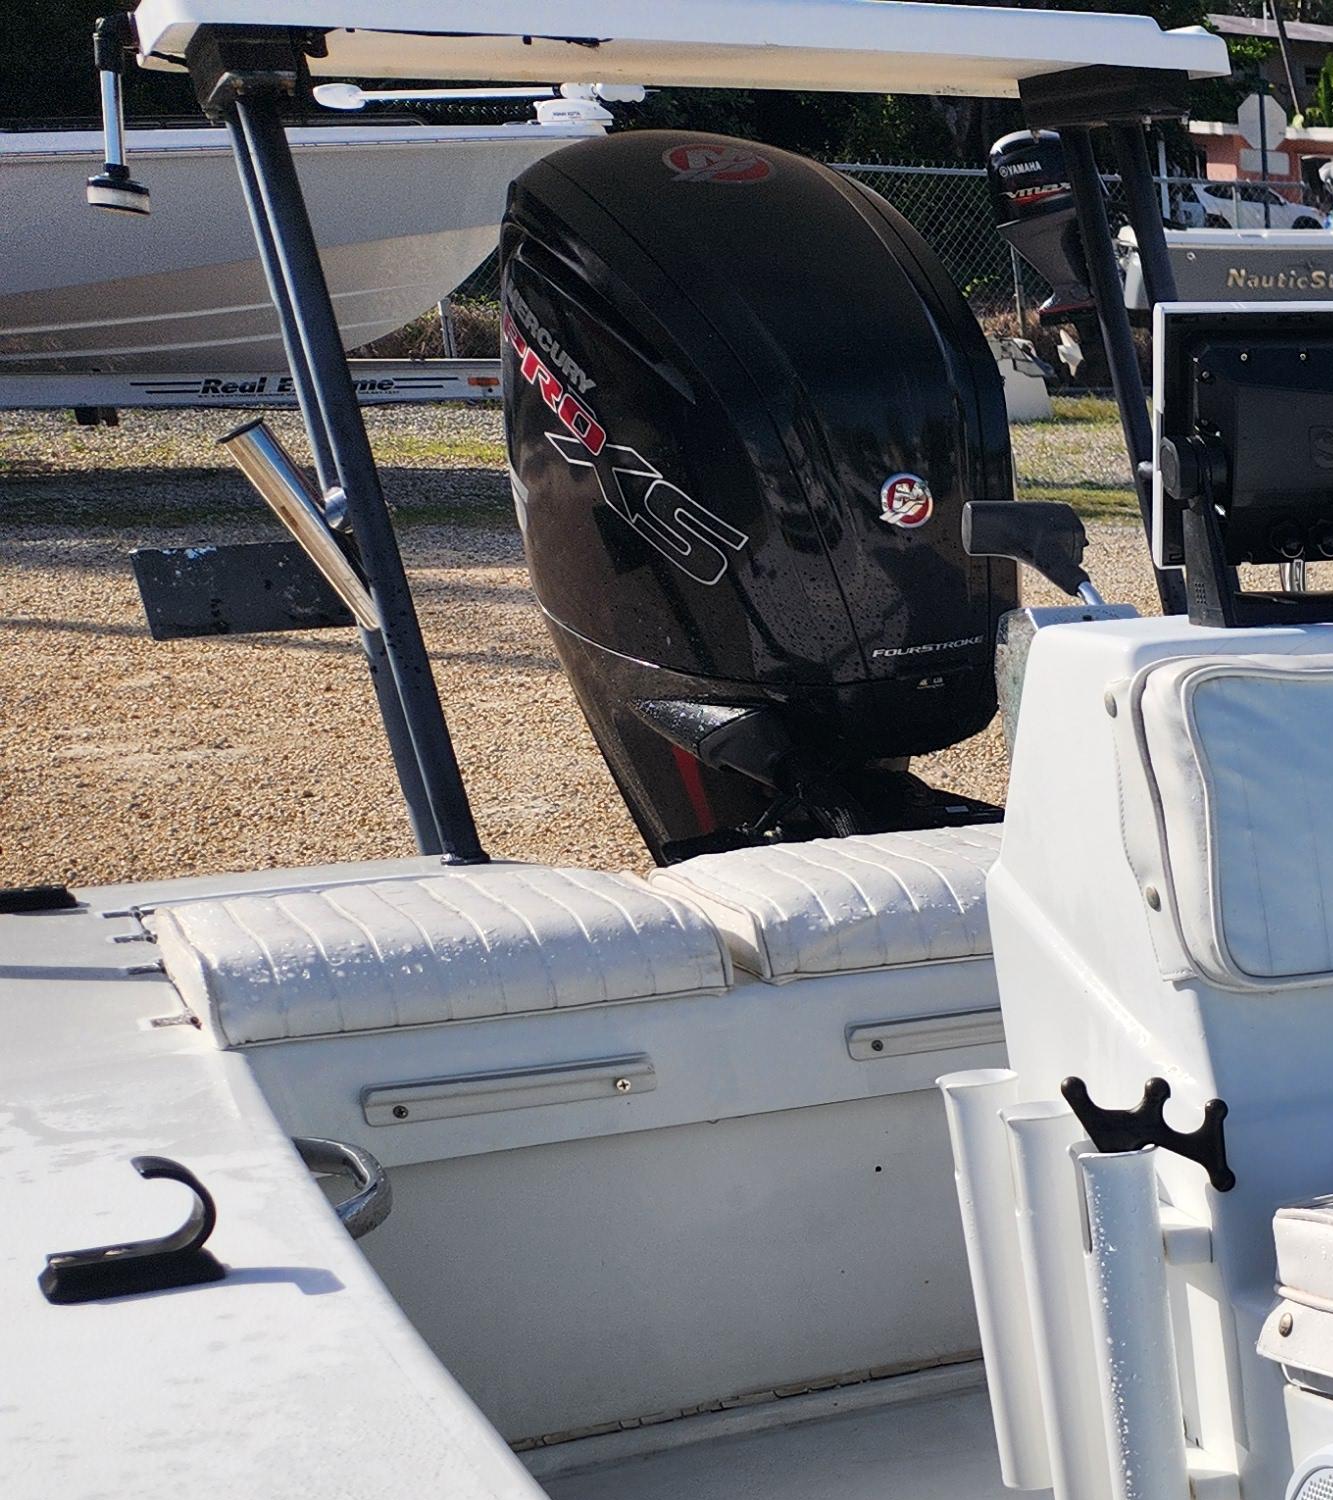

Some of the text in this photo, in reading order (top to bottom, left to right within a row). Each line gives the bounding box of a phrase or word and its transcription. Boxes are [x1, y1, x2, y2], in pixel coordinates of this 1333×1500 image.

[1008, 161, 1042, 175] YAMAHA
[201, 377, 267, 394] Real
[502, 304, 606, 456] PRO
[543, 431, 749, 585] XS
[872, 635, 984, 658] FOURSTROKE
